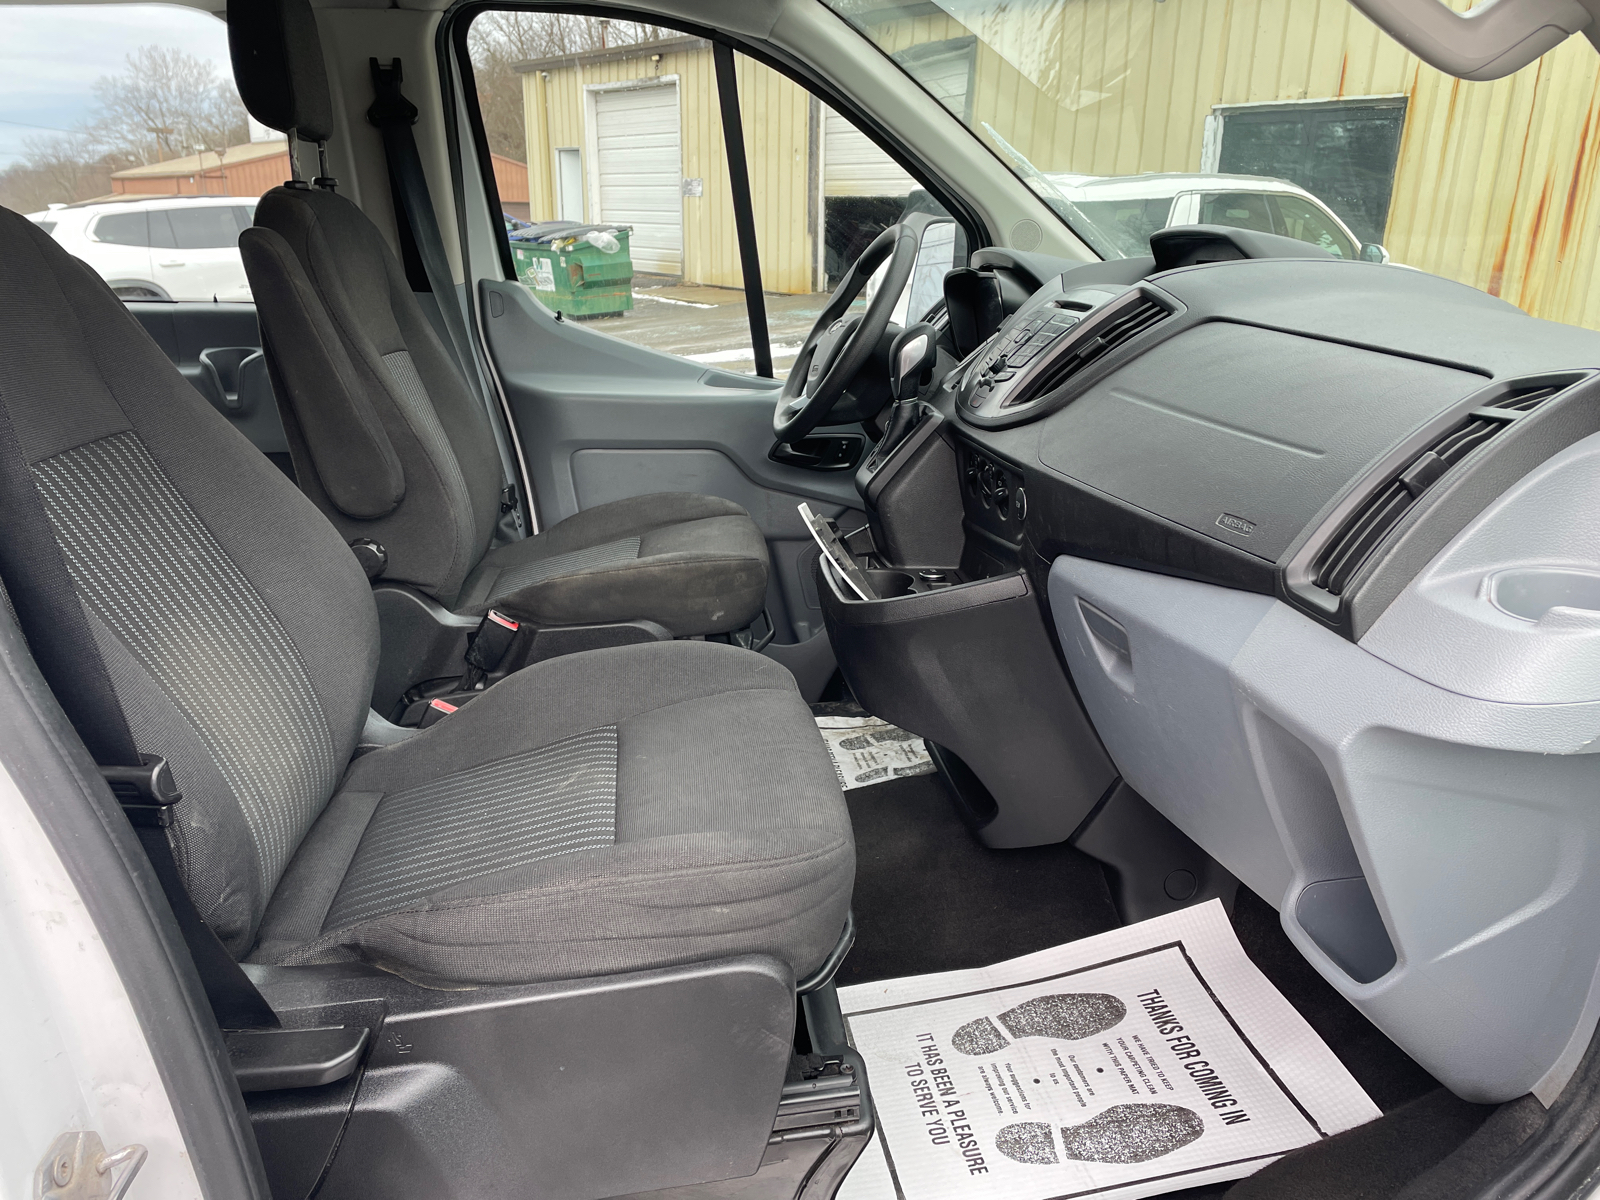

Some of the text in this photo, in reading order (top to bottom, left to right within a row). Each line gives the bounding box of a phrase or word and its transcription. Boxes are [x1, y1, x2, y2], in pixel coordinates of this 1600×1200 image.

[1102, 1042, 1140, 1095] WITH THIS PAPER MAT
[1116, 1037, 1158, 1095] YOUR CARPETING CLEAN
[1132, 1035, 1174, 1091] WE HAVE TRIED TO KEEP
[1137, 989, 1251, 1125] THANKS FOR COMING IN
[904, 1062, 951, 1145] TO SERVE YOU
[916, 1032, 989, 1176] IT HAS BEEN A PLEASURE
